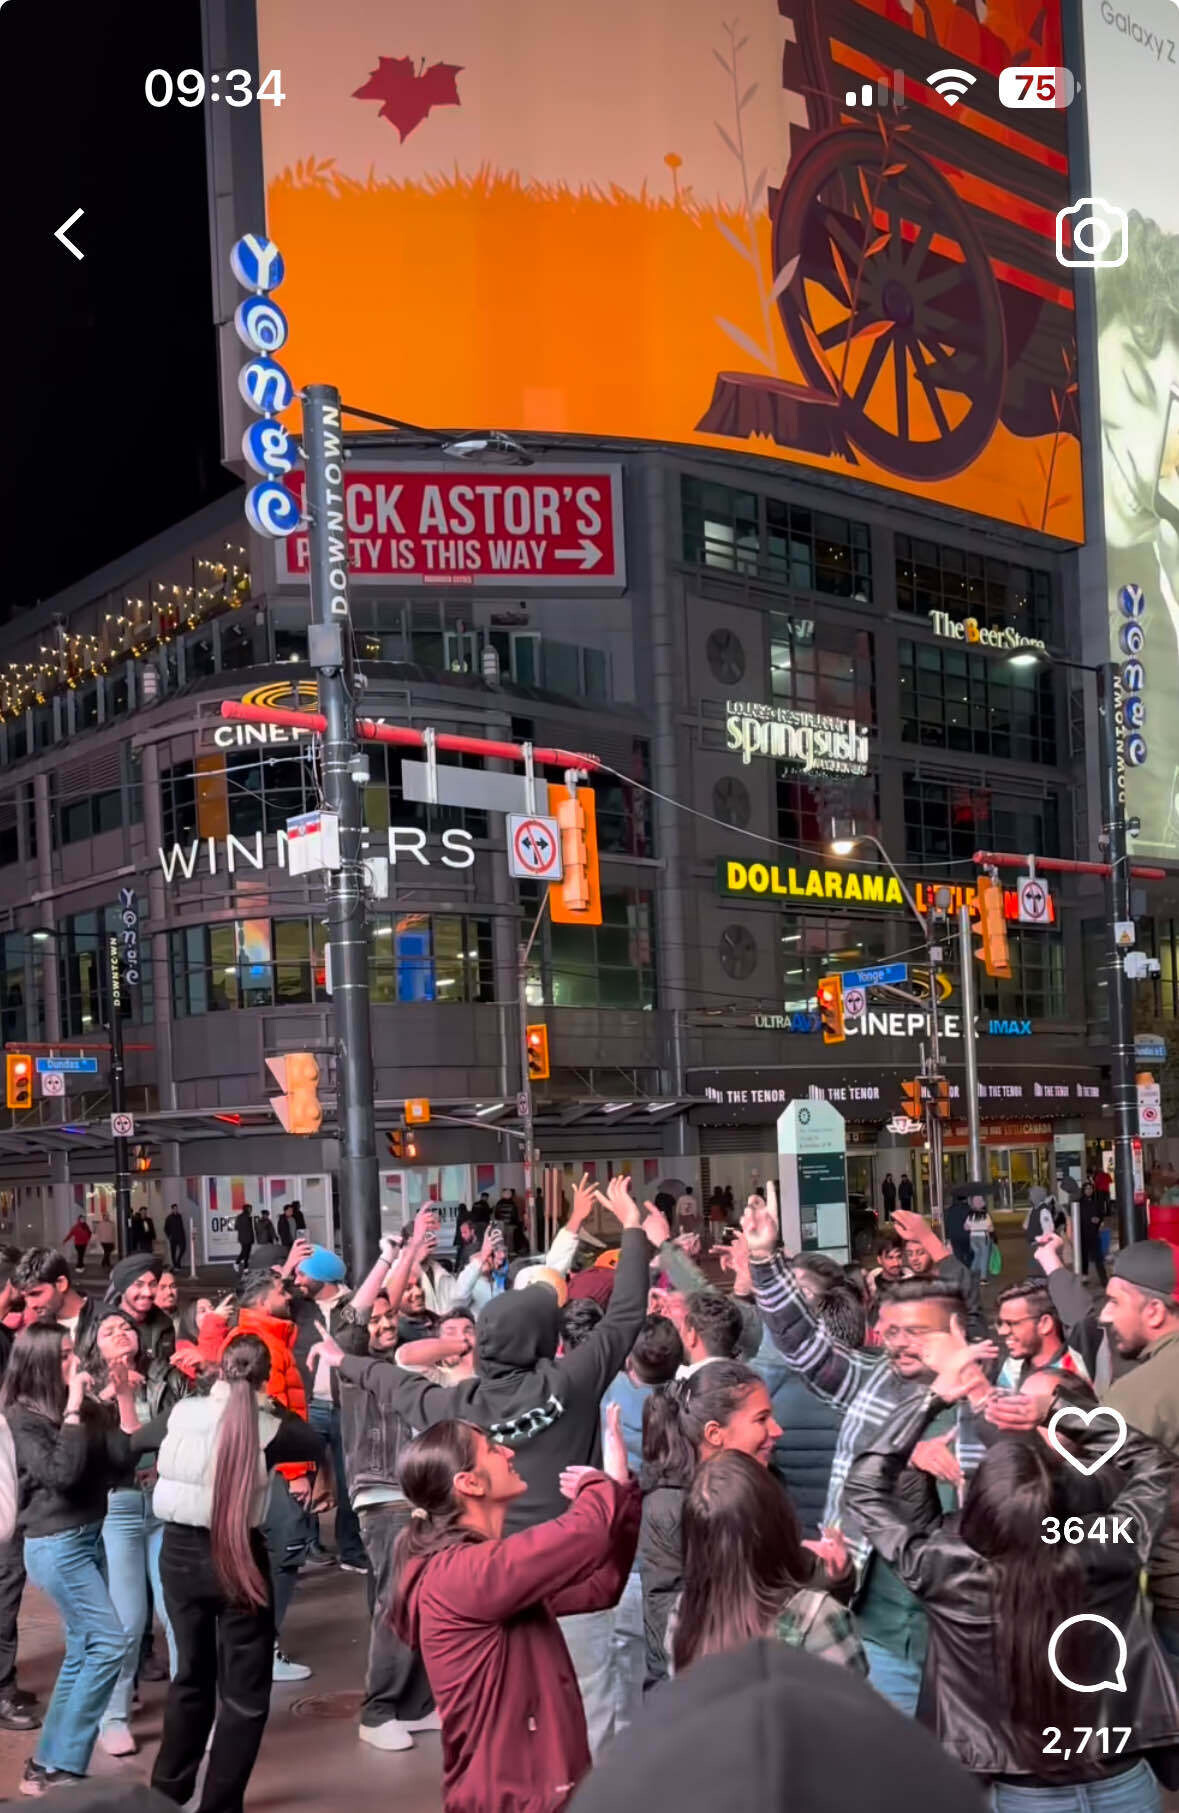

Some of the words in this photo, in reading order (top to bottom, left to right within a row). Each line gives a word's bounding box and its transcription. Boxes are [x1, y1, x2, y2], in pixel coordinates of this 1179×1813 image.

[1101, 1, 1164, 60] Galaxy
[1166, 39, 1176, 64] Z
[242, 233, 296, 536] Yonge
[295, 483, 405, 534] CK
[418, 485, 601, 536] ASTOR'S
[322, 405, 349, 615] DOWNTOWN
[296, 539, 383, 568] PTY
[391, 539, 416, 569] IS
[421, 540, 482, 571] THIS
[488, 540, 547, 570] WAY
[1122, 583, 1147, 767] Yonge
[1113, 675, 1126, 804] DOWNTOWN
[158, 826, 476, 883] WINRS
[727, 861, 903, 904] DOLLARAMA
[110, 936, 121, 1007] DOWNTOWN
[989, 1019, 1032, 1035] IMAX
[727, 1090, 748, 1103] THE
[751, 1089, 786, 1103] TENOR
[827, 1088, 847, 1100] THE
[850, 1087, 880, 1100] TENOR
[988, 1085, 1002, 1098] THE
[1002, 1085, 1023, 1097] TENOR
